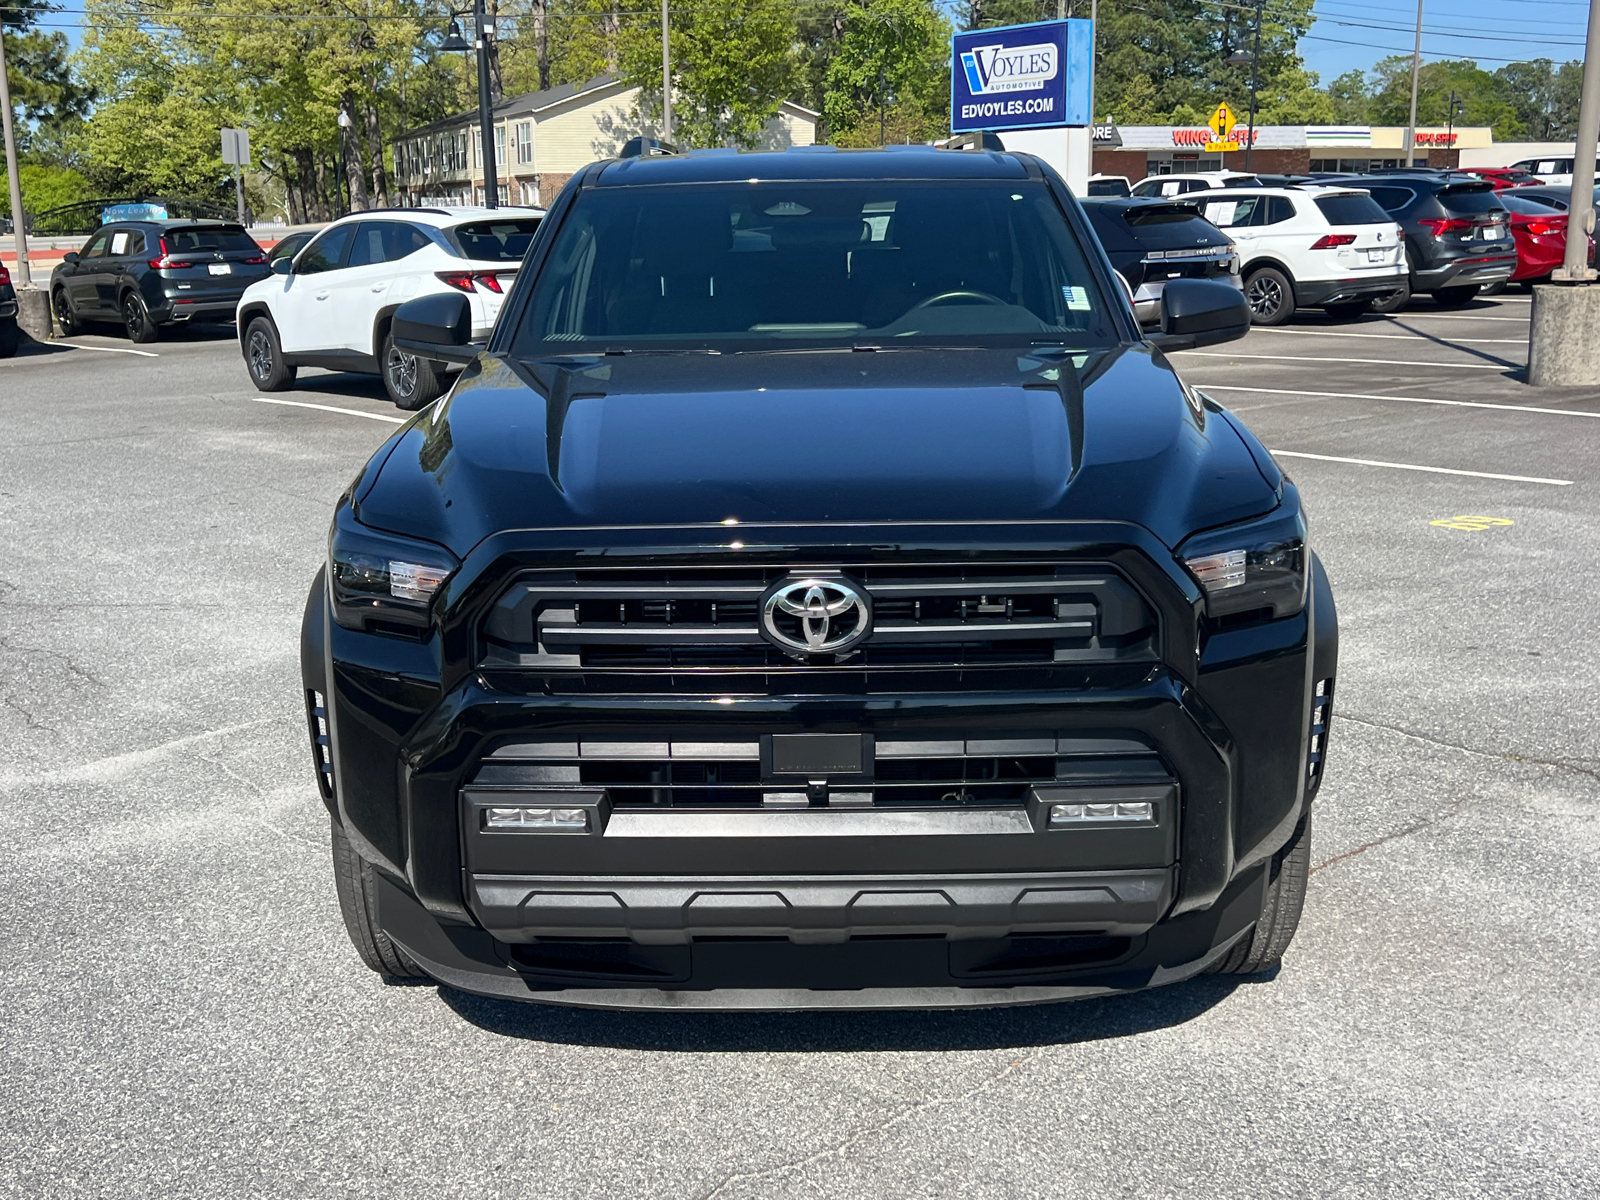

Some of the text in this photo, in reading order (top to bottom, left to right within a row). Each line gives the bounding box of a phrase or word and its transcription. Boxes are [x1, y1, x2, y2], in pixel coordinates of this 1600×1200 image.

[966, 48, 1051, 87] ED VOYLES
[990, 80, 1042, 91] AUTOMOTIVE
[961, 97, 1054, 119] EDVOYLES.COM
[1172, 129, 1211, 146] WING
[104, 206, 164, 215] Now Leasing
